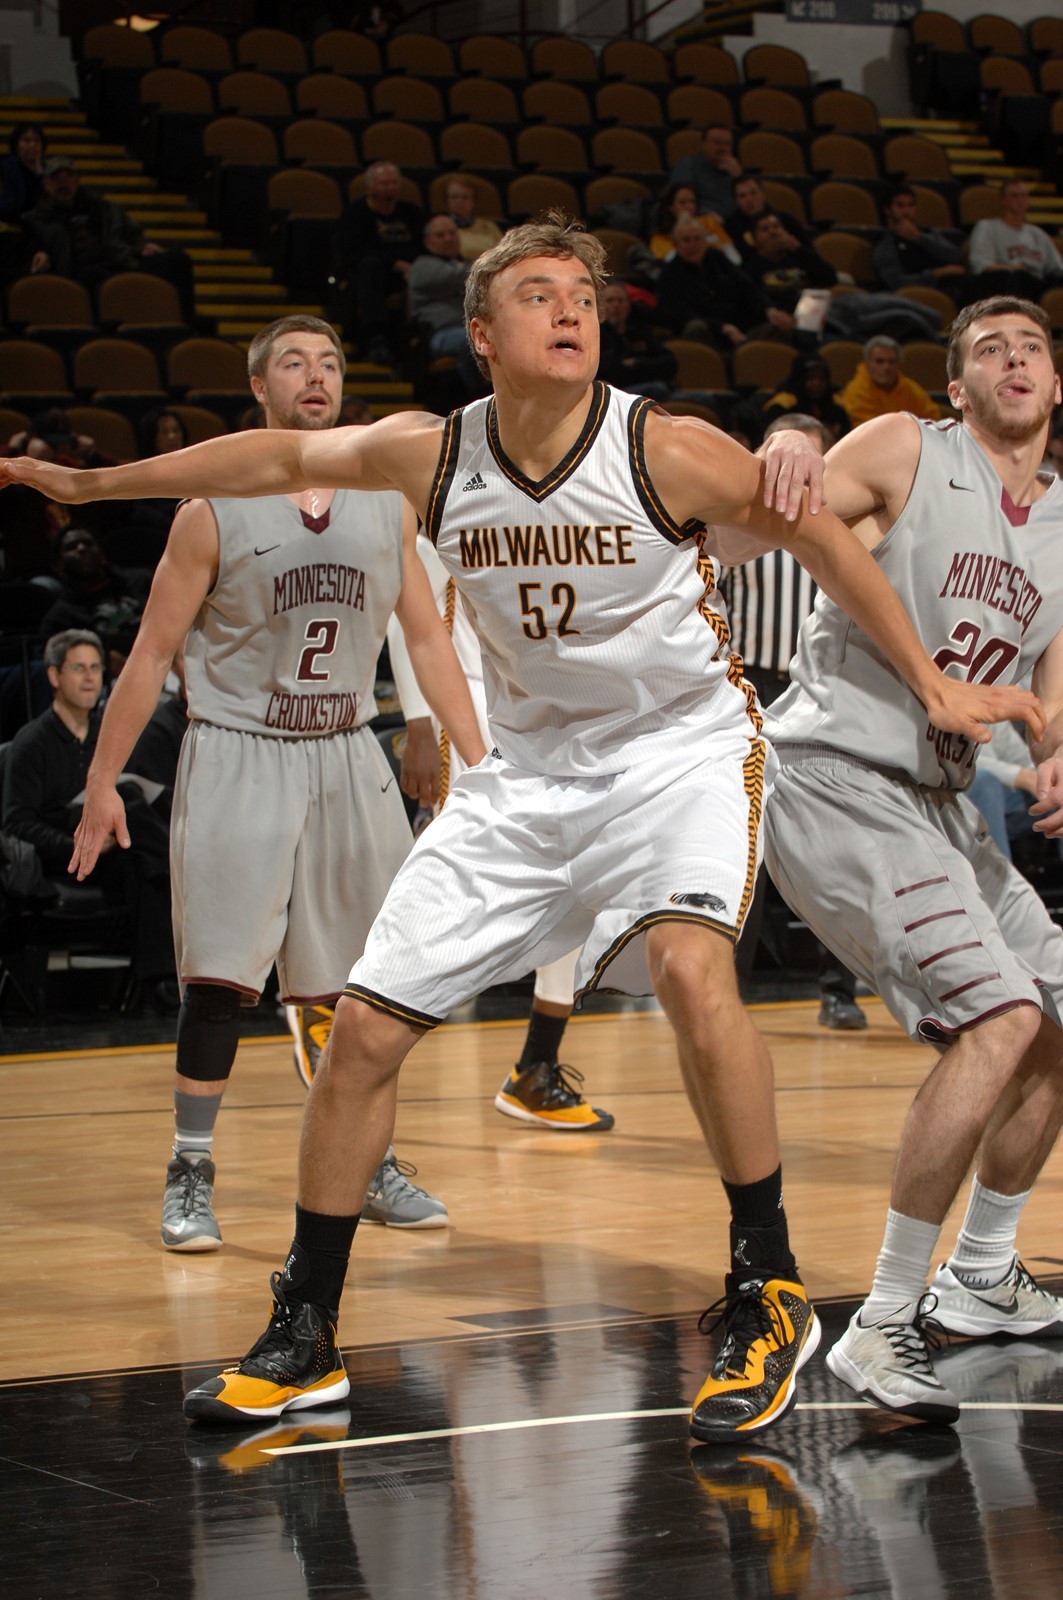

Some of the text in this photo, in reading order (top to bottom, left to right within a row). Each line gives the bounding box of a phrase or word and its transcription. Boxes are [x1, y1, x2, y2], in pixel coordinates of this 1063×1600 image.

[462, 481, 488, 492] adidas
[459, 525, 637, 568] MILWAUKEE
[273, 563, 366, 615] MINNESOTA
[518, 582, 581, 640] 52
[295, 618, 340, 682] 2
[931, 618, 1020, 687] 20
[265, 690, 358, 732] CROOKSTON
